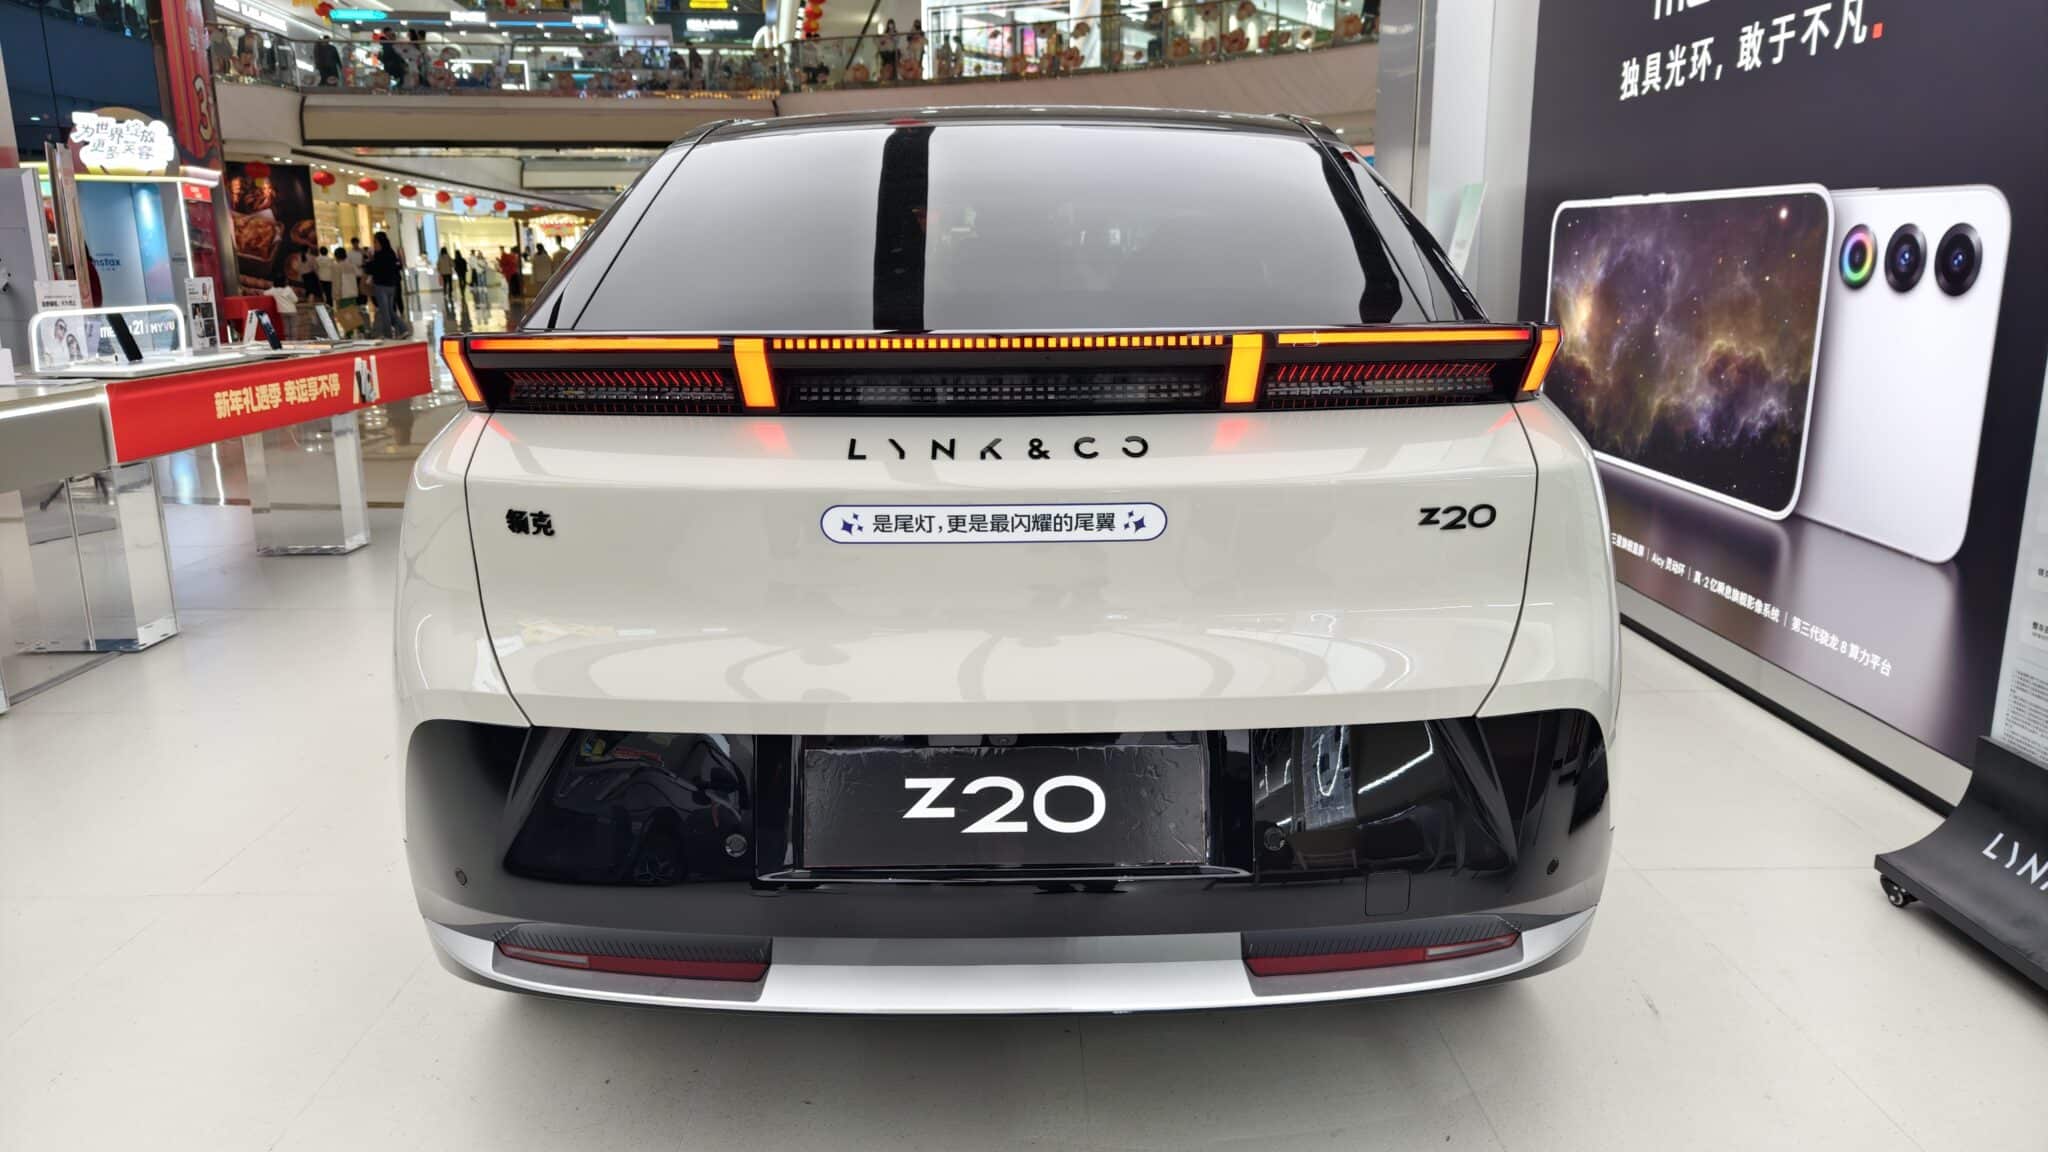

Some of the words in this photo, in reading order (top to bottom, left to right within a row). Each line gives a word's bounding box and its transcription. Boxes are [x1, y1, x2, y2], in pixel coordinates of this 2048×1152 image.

[93, 258, 121, 266] nstax
[150, 321, 175, 334] MYVU
[284, 373, 341, 405] 幸运享不停
[1982, 832, 2048, 890] LYN
